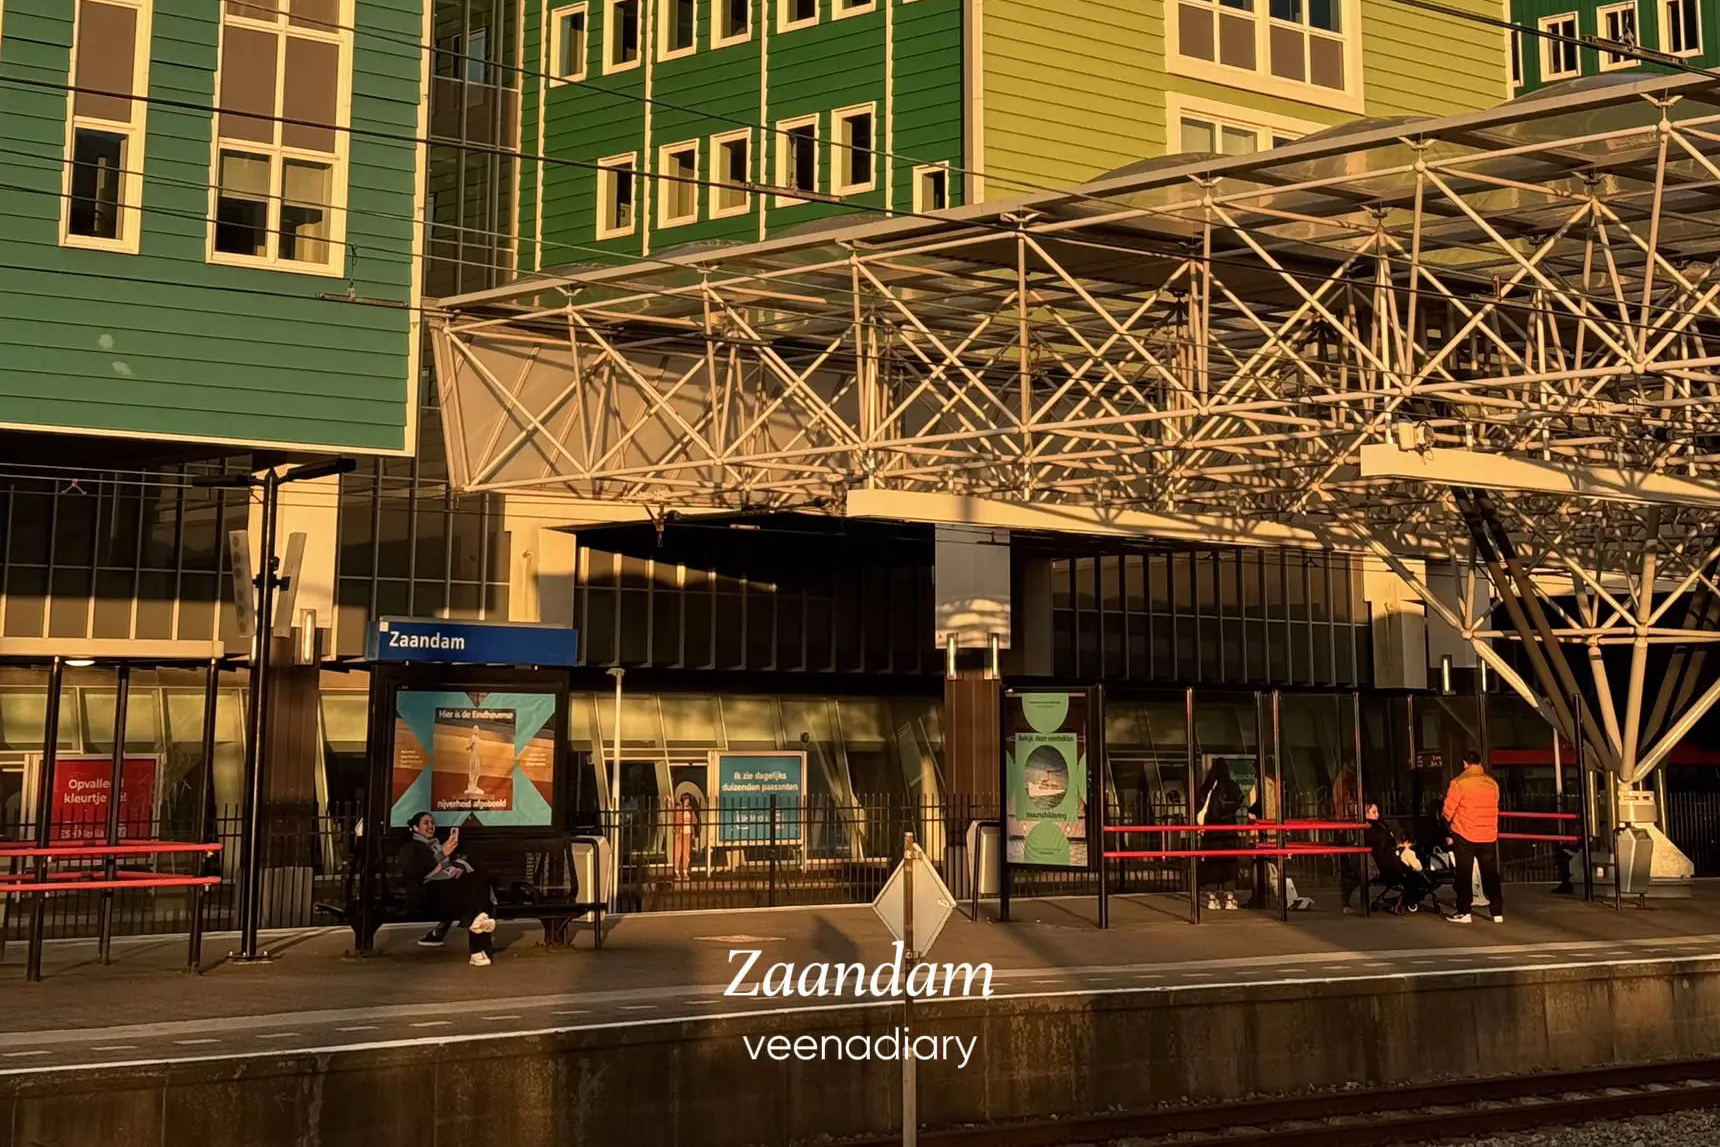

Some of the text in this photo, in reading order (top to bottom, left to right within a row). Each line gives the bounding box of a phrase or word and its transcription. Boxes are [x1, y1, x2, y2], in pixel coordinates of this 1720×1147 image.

[389, 630, 465, 650] Zaandam
[438, 709, 514, 720] Hier is de Eindhovense
[733, 771, 787, 781] Ik zie dagelijks
[68, 777, 125, 792] Opvalle
[722, 783, 798, 793] duizenden passanten
[64, 792, 107, 806] kleurtje
[437, 798, 507, 810] nijverheid afgebeeld
